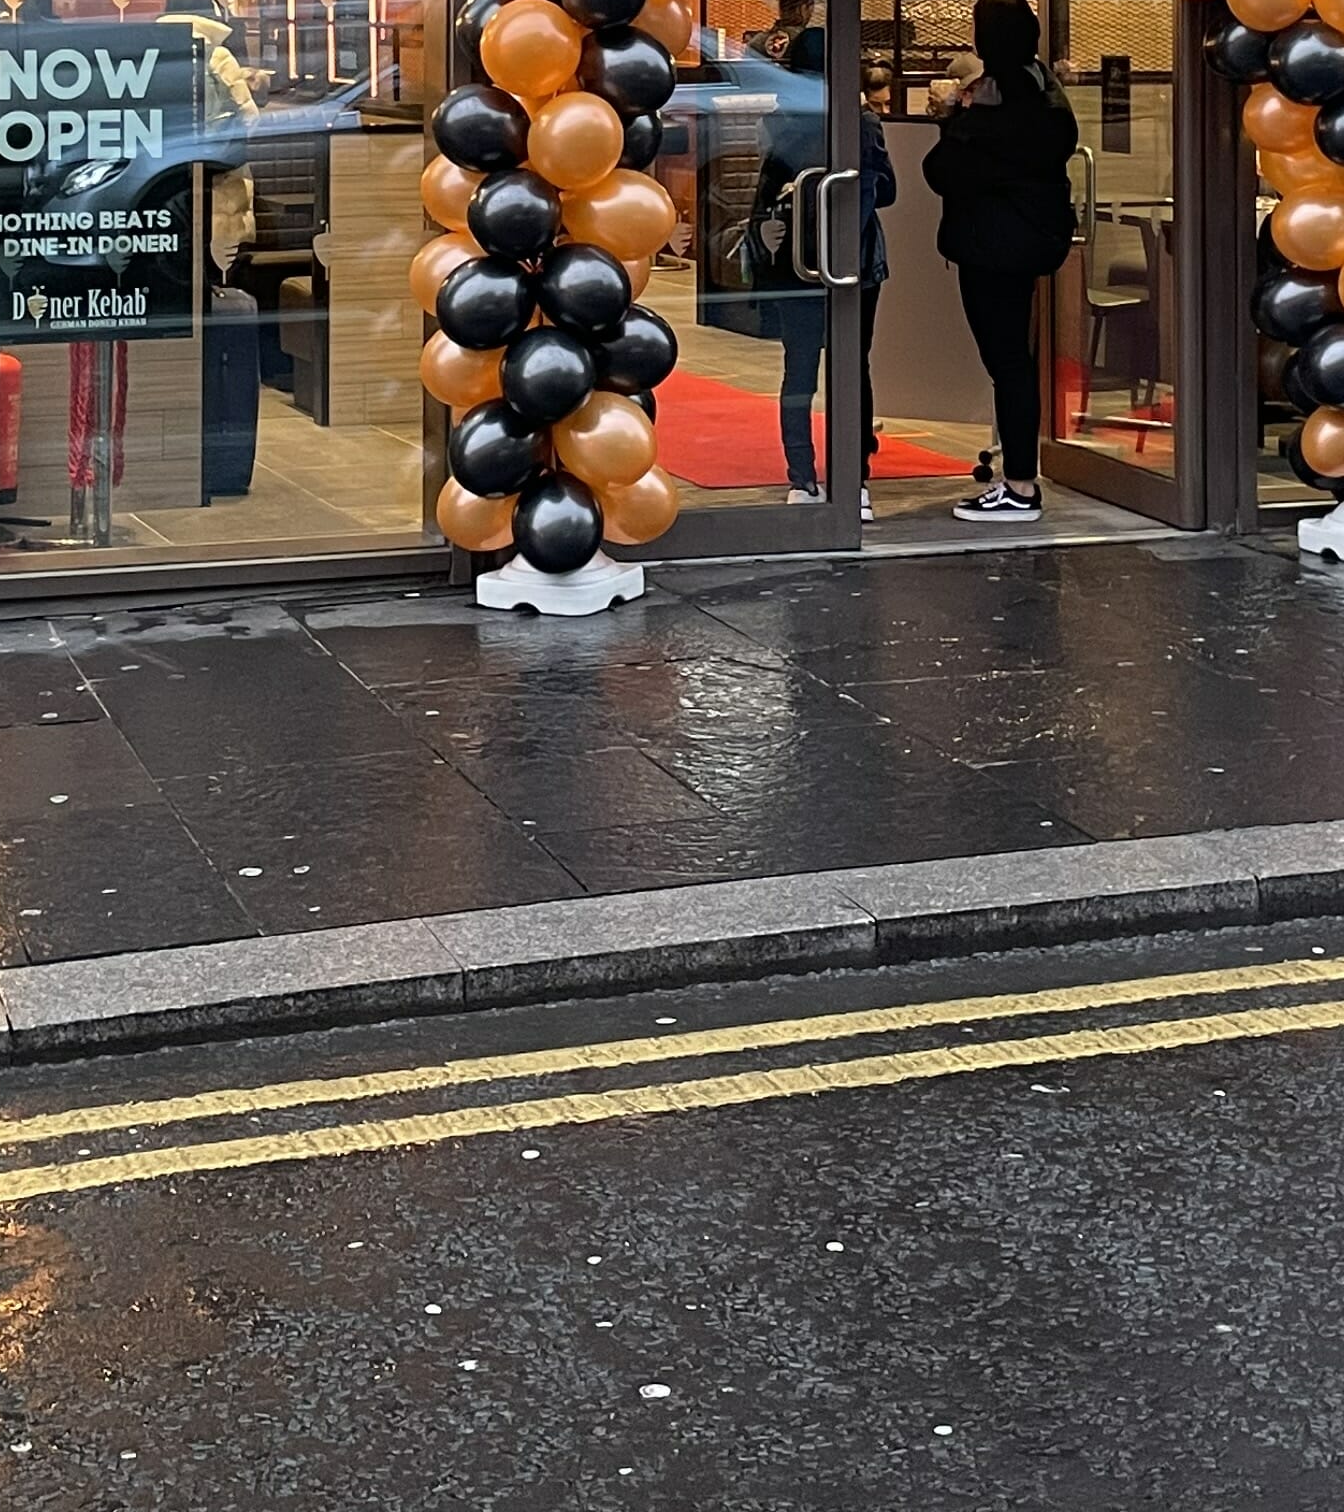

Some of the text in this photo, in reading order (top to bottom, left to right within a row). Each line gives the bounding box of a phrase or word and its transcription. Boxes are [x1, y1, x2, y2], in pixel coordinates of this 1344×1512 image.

[99, 210, 172, 229] BEATS
[4, 236, 93, 257] DINE-IN
[98, 234, 178, 254] DONER!
